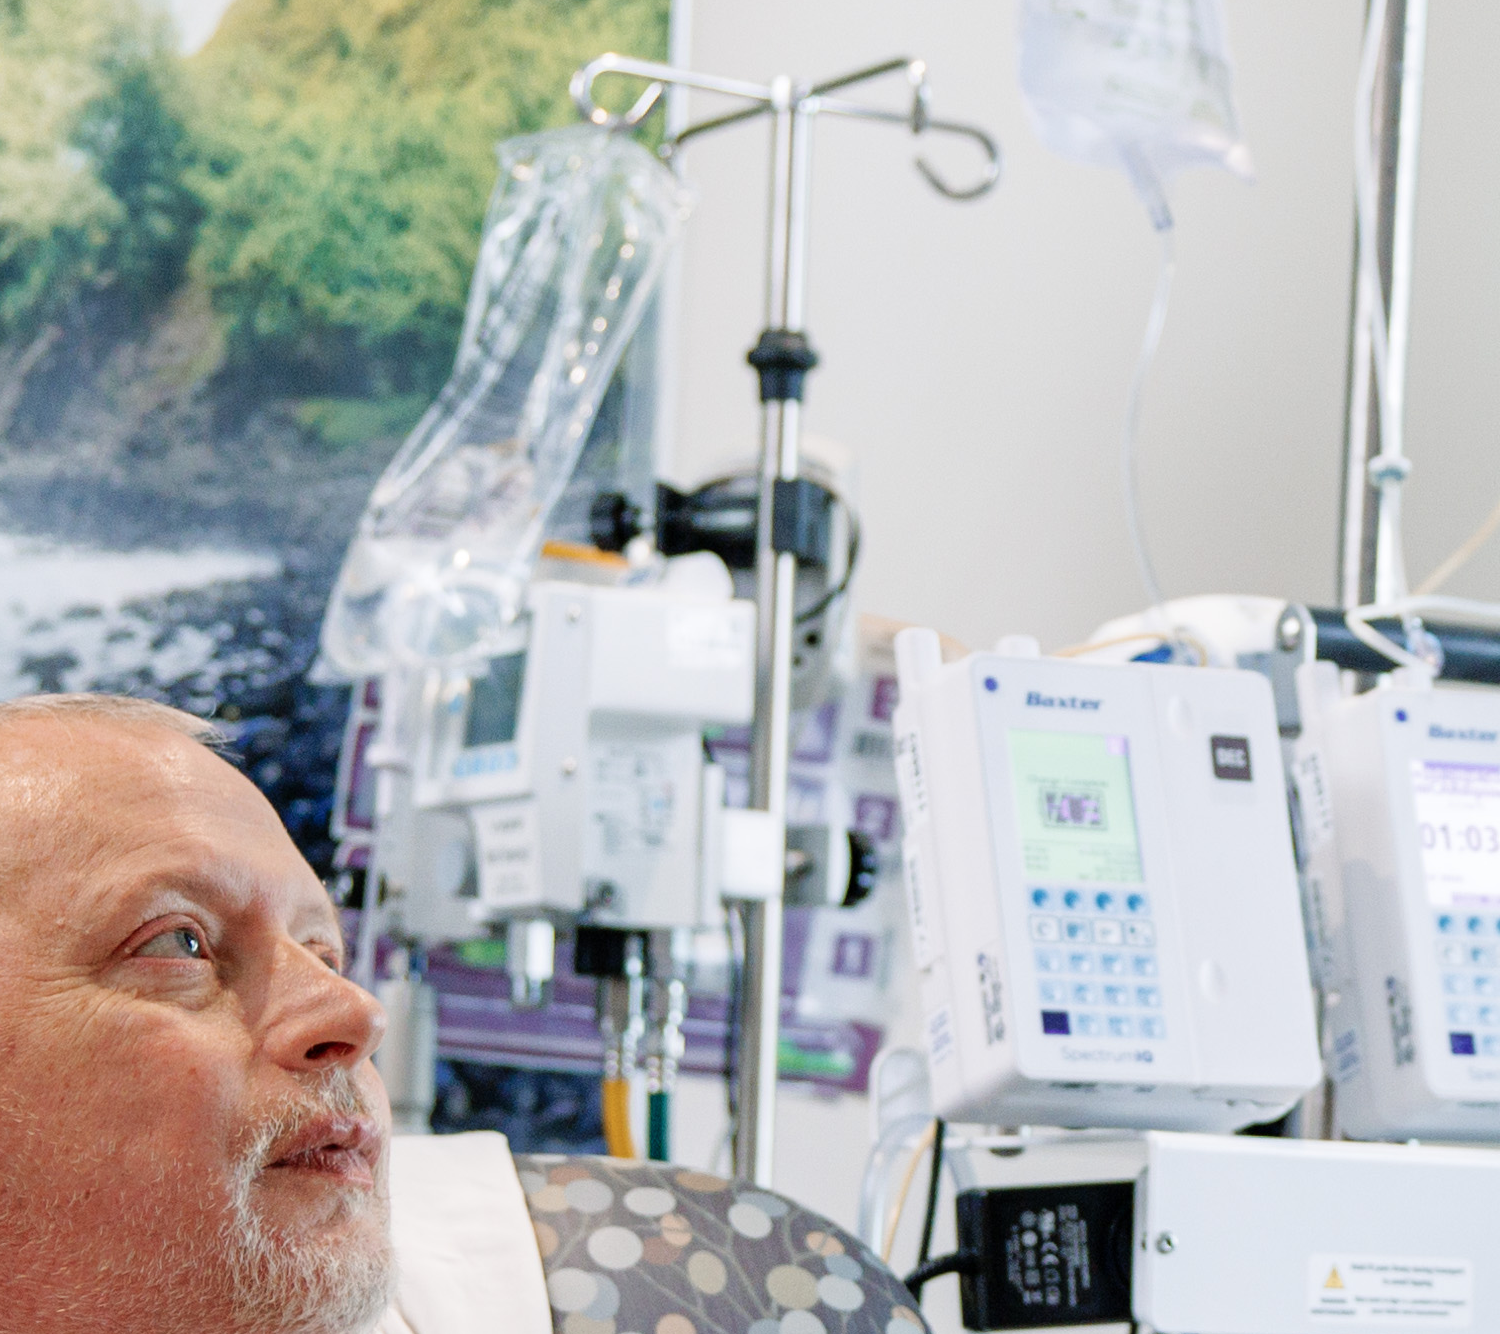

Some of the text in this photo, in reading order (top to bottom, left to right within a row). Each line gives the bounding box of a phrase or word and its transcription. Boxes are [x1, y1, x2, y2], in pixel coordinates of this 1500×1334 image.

[1025, 691, 1103, 711] Baxter
[1428, 724, 1498, 742] Baxter
[1418, 822, 1500, 853] 01:03
